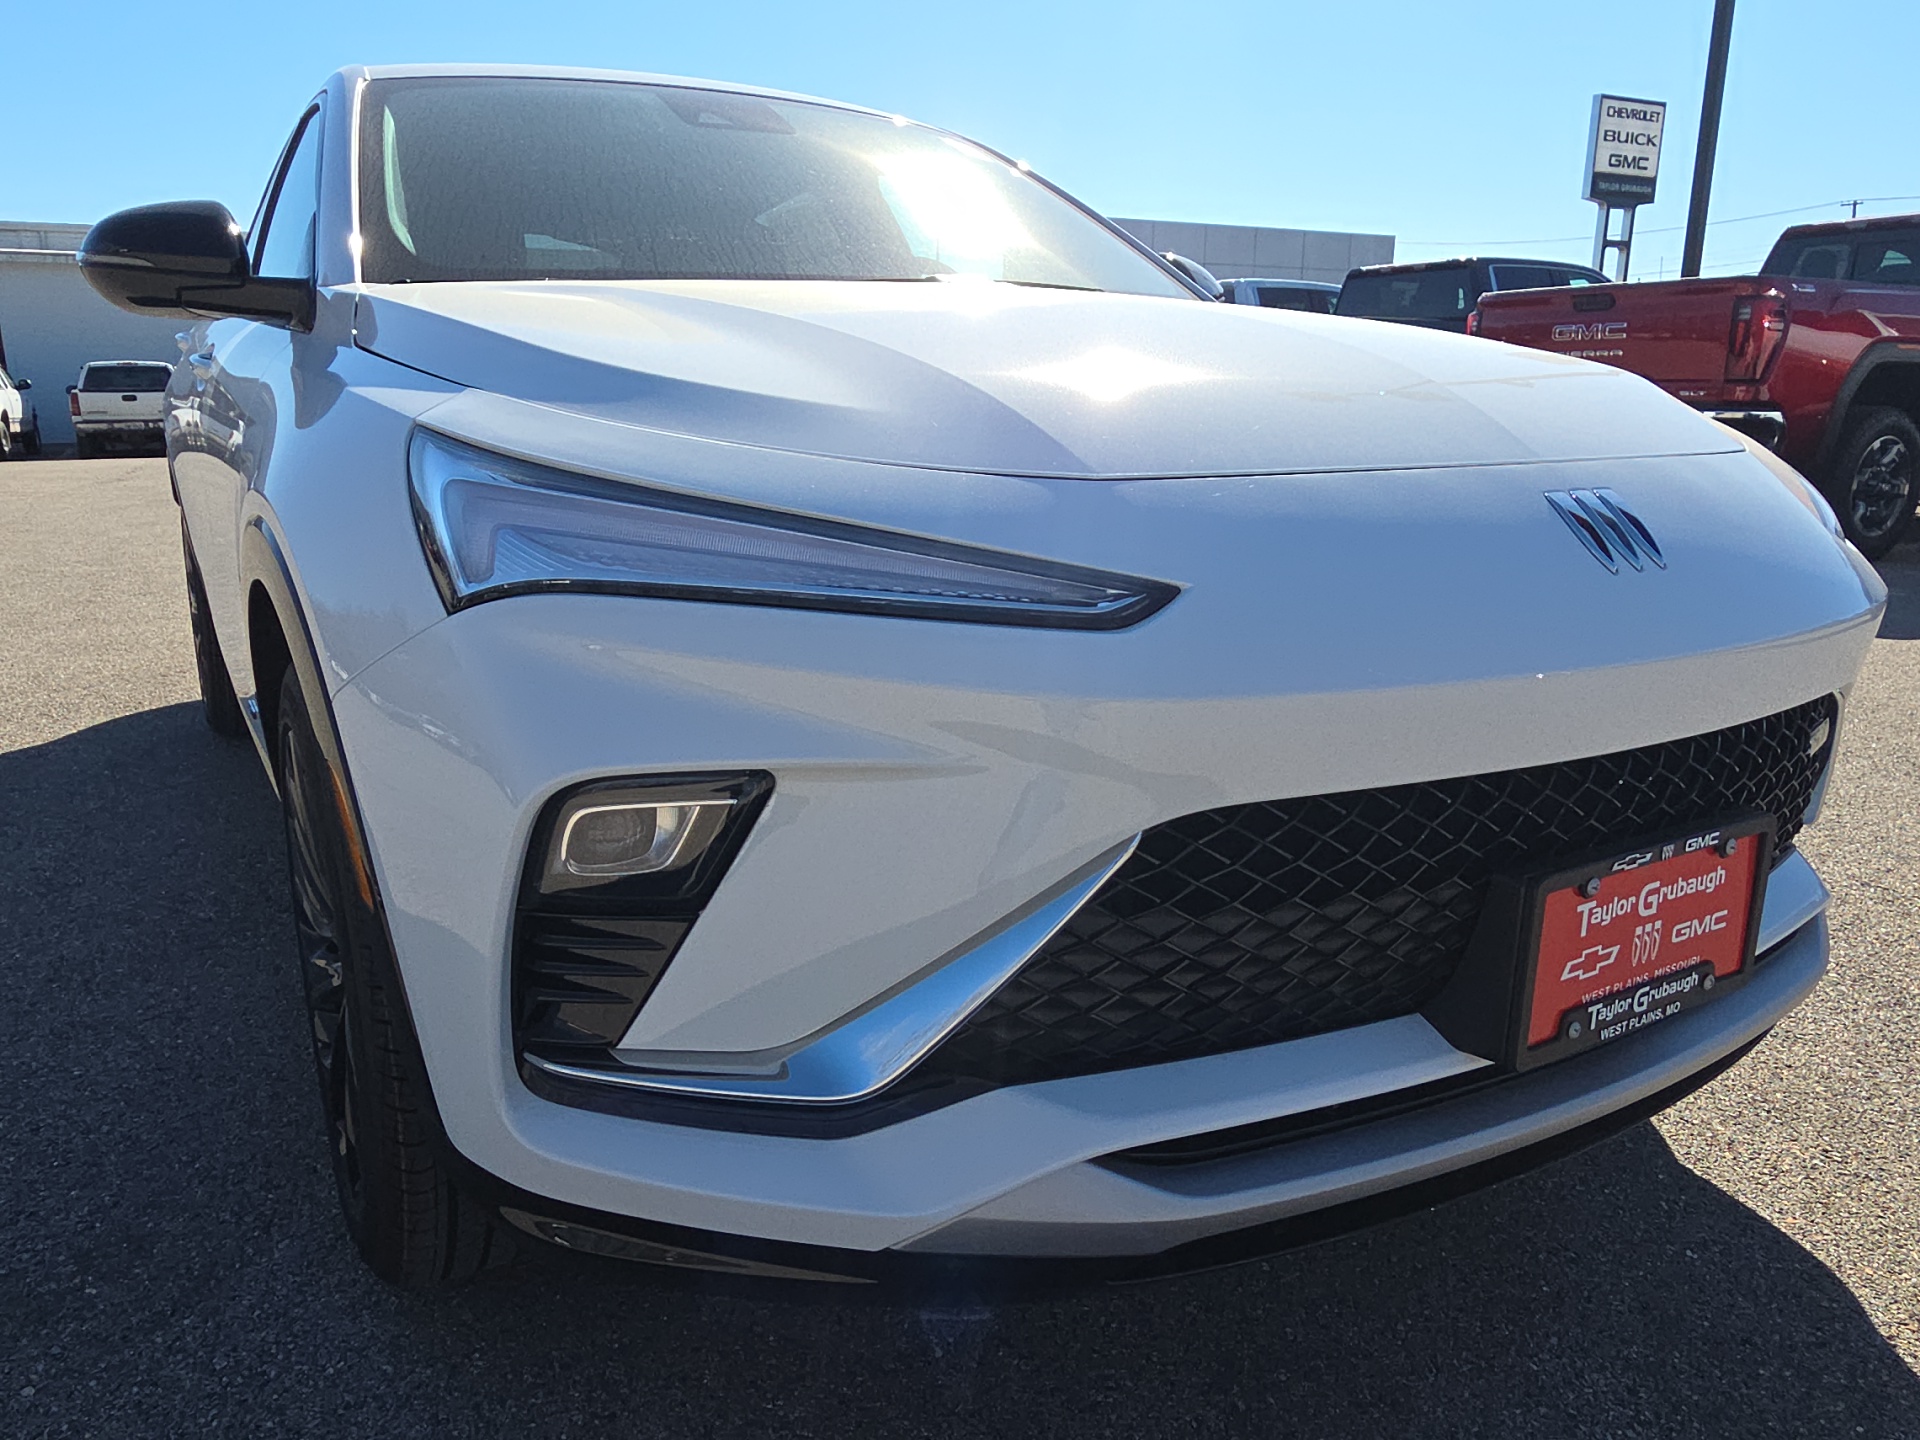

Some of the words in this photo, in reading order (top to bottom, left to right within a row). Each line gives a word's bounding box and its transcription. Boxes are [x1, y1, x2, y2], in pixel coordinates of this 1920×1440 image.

[1606, 105, 1660, 123] CHEVROLET
[1603, 129, 1658, 147] BUICK
[1608, 153, 1650, 171] GMC
[1551, 322, 1628, 341] GMC
[1557, 349, 1623, 358] IERRA
[1685, 831, 1720, 852] GMC
[1576, 895, 1636, 938] Taylor
[1638, 865, 1726, 917] Grubaugh
[1671, 909, 1728, 943] GMC
[1581, 985, 1611, 1004] WEST
[1653, 955, 1701, 979] MISSOURI
[1588, 997, 1632, 1030] Taylor
[1632, 971, 1699, 1013] Grubaugh
[1600, 1021, 1628, 1040] WEST
[1628, 1008, 1664, 1030] PLAINS,
[1665, 1001, 1681, 1016] MO
